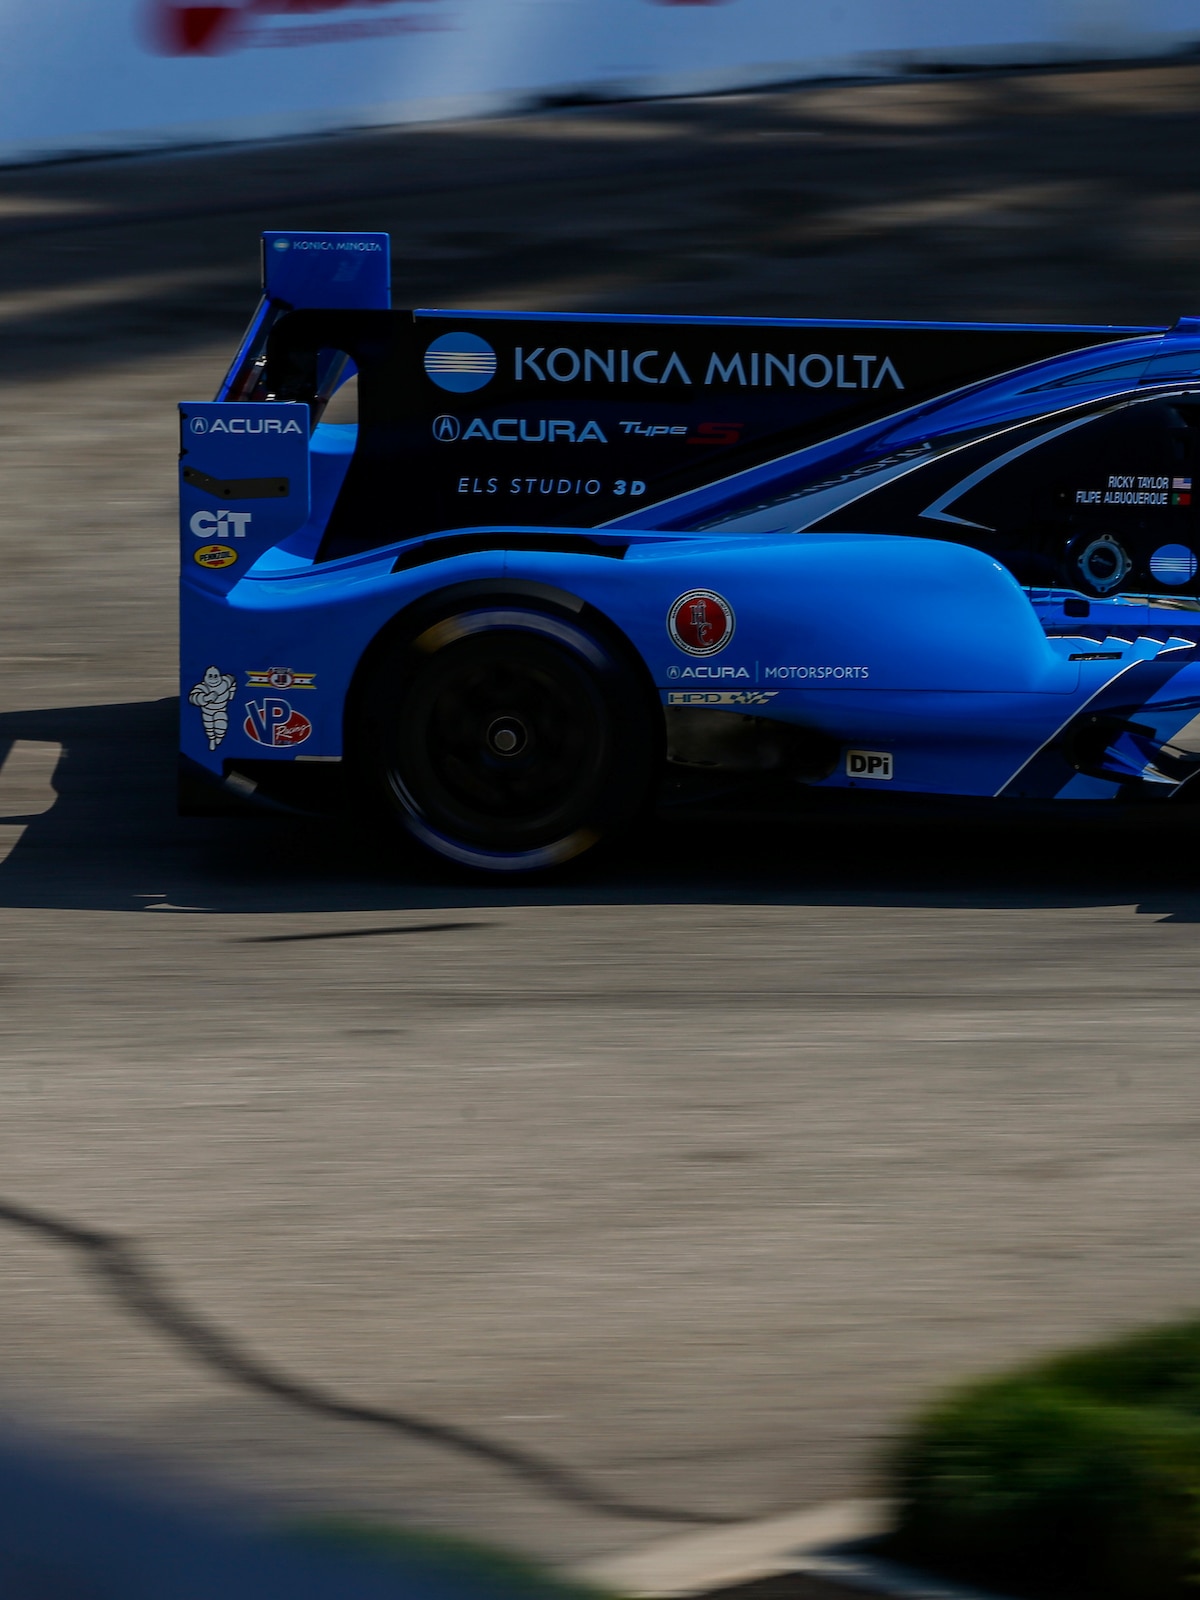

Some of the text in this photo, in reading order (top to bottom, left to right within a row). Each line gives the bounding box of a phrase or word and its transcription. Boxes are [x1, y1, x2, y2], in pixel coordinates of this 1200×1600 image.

[293, 241, 382, 251] KONICA MINOLTA
[513, 346, 905, 389] KONICA MINOLTA
[209, 419, 303, 434] ACURA
[461, 418, 609, 443] ACURA
[618, 421, 688, 437] Type
[457, 477, 647, 496] ELS STUDIO 3D
[1108, 475, 1169, 489] RICKY TAYLOR
[1076, 491, 1168, 505] FILIPE ALBUQUERQUE
[680, 667, 869, 679] ACURA MOTORSPORTS
[670, 693, 722, 703] HPD
[244, 697, 292, 747] VP
[851, 755, 889, 775] DPi
